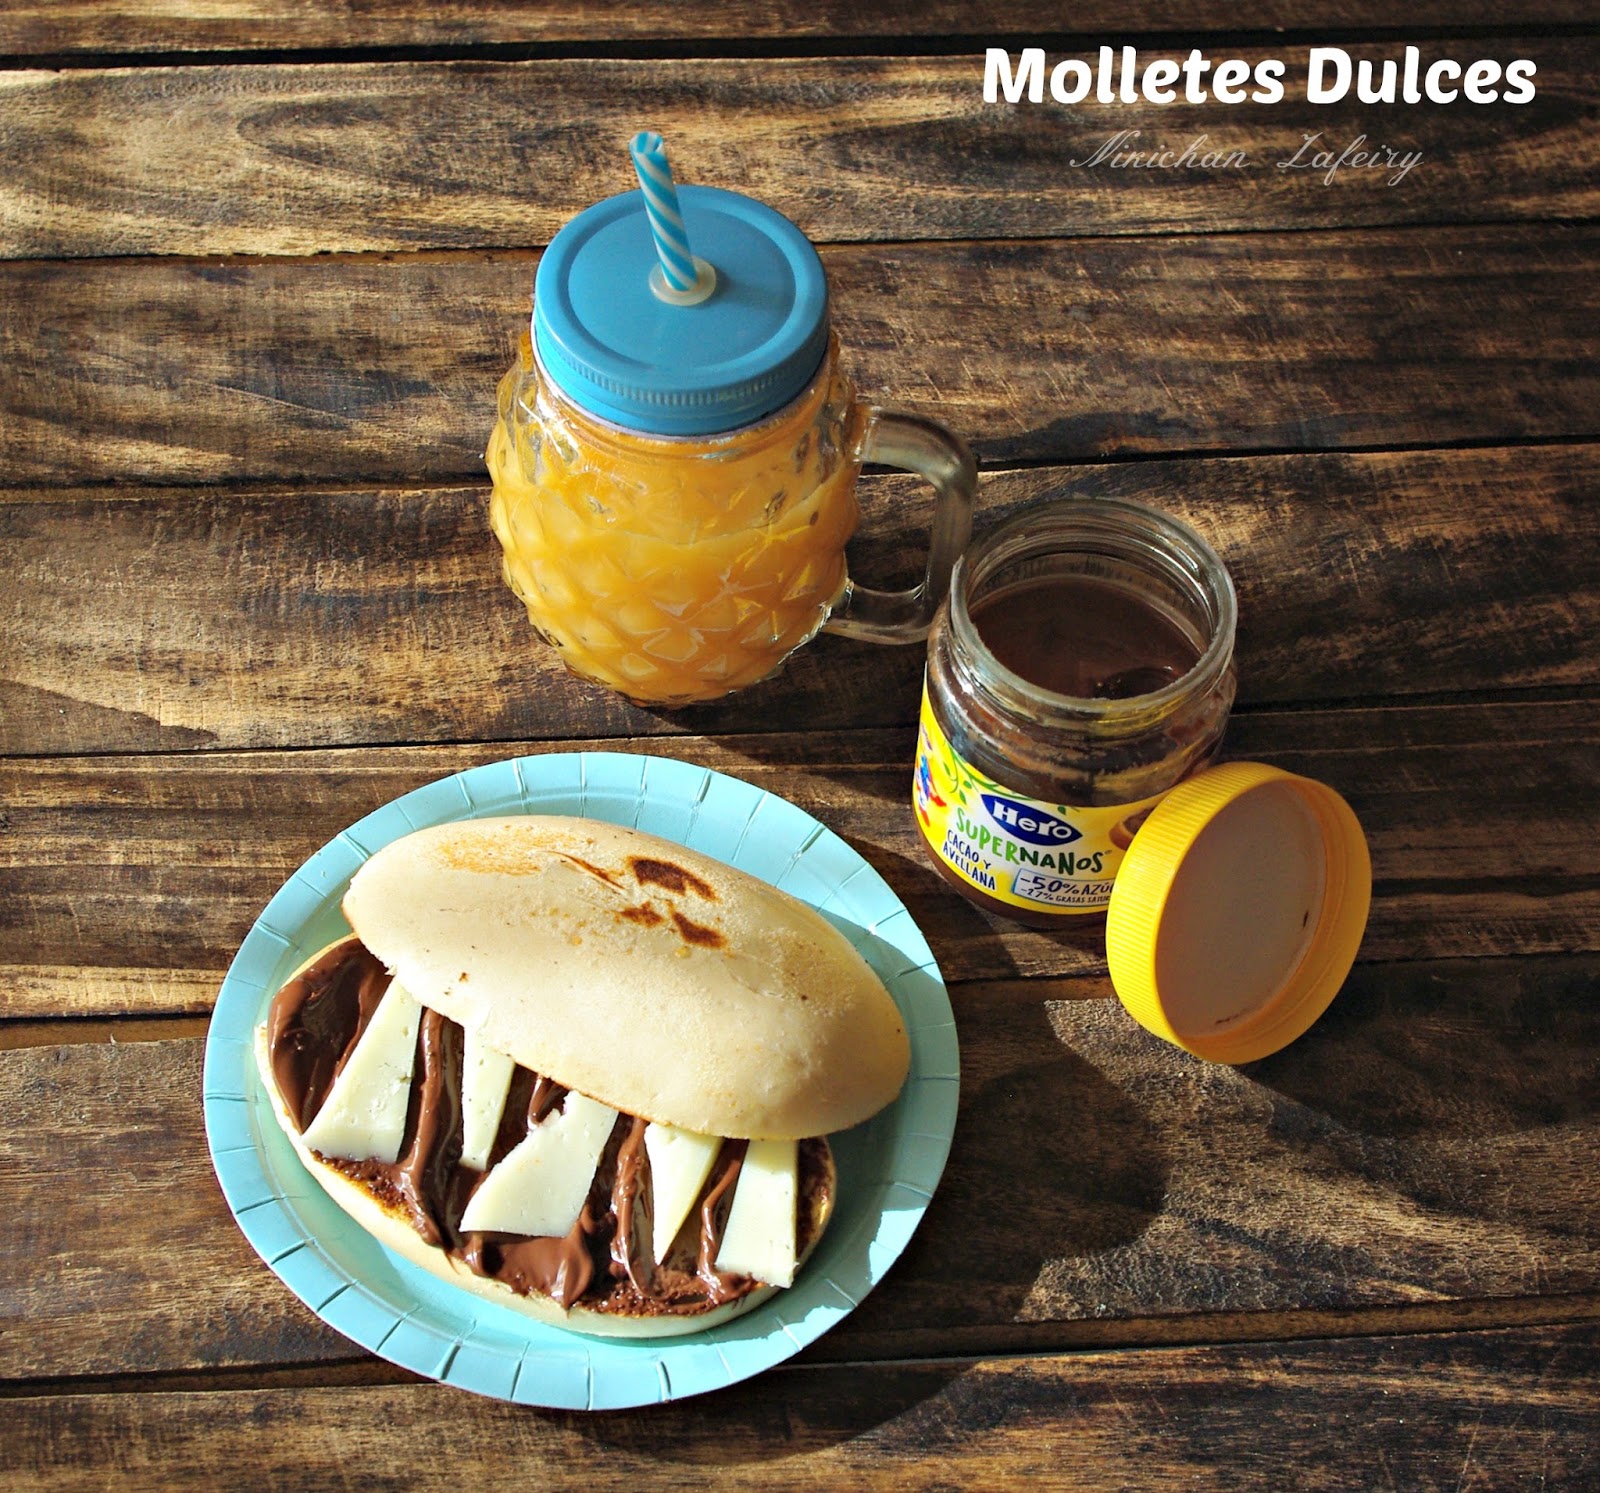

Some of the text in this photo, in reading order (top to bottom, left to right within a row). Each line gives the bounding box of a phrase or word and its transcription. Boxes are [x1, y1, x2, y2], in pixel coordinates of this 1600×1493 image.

[992, 800, 1072, 839] Hero
[943, 842, 996, 890] AVELLANA
[947, 830, 991, 870] CACAO Y
